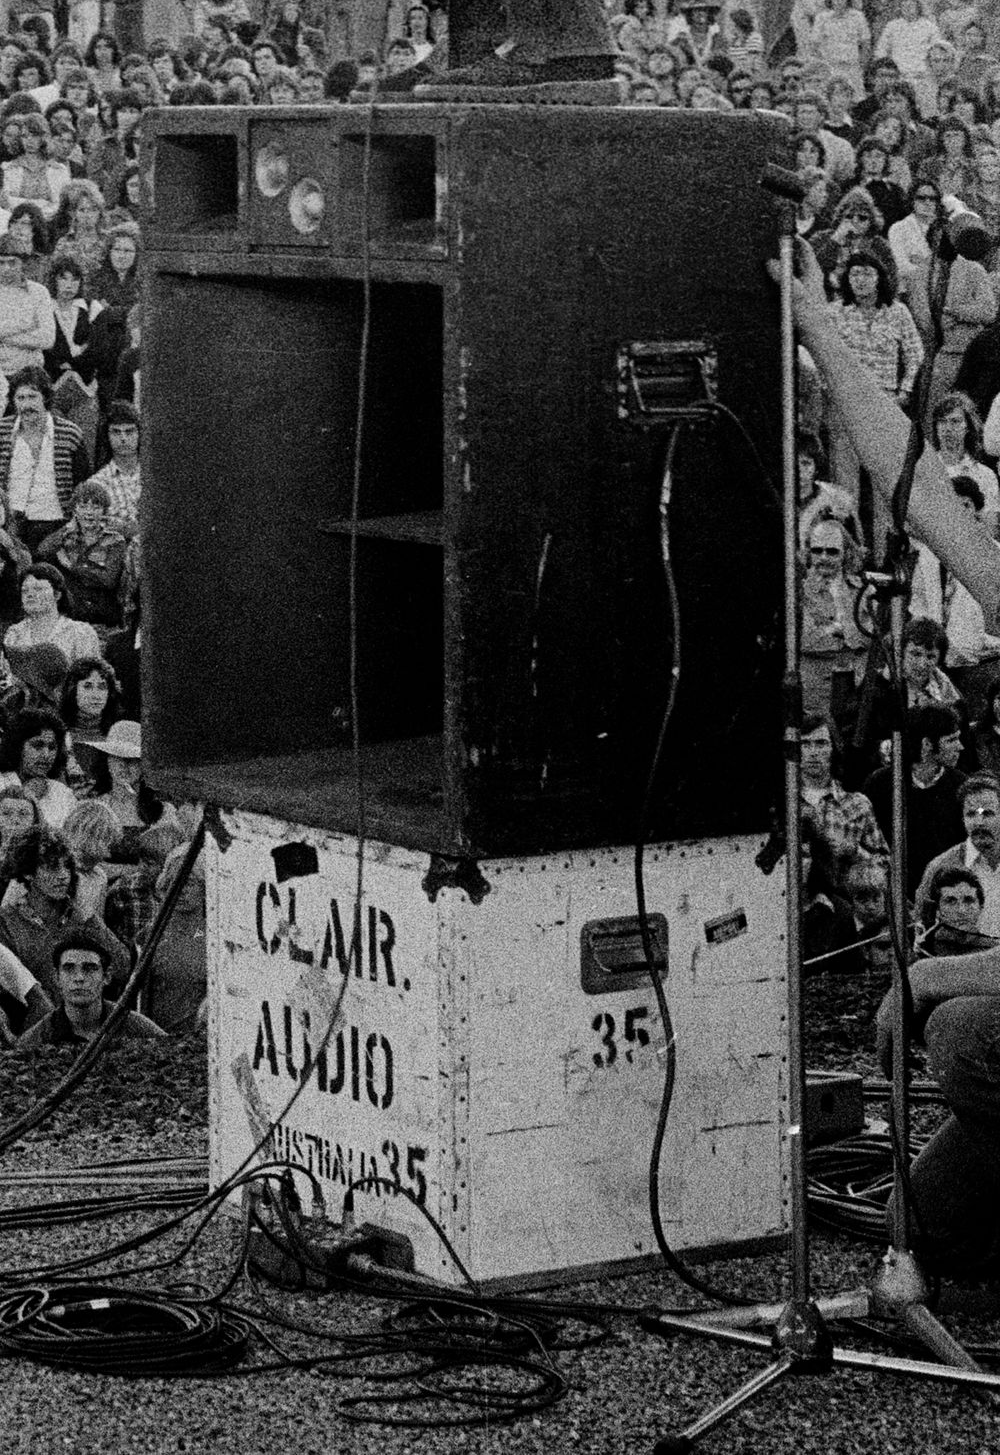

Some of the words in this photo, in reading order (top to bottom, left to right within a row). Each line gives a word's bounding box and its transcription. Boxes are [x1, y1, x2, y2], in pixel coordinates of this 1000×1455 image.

[253, 1001, 394, 1110] AUDIO
[592, 1006, 650, 1069] 35
[382, 1139, 426, 1206] 35
